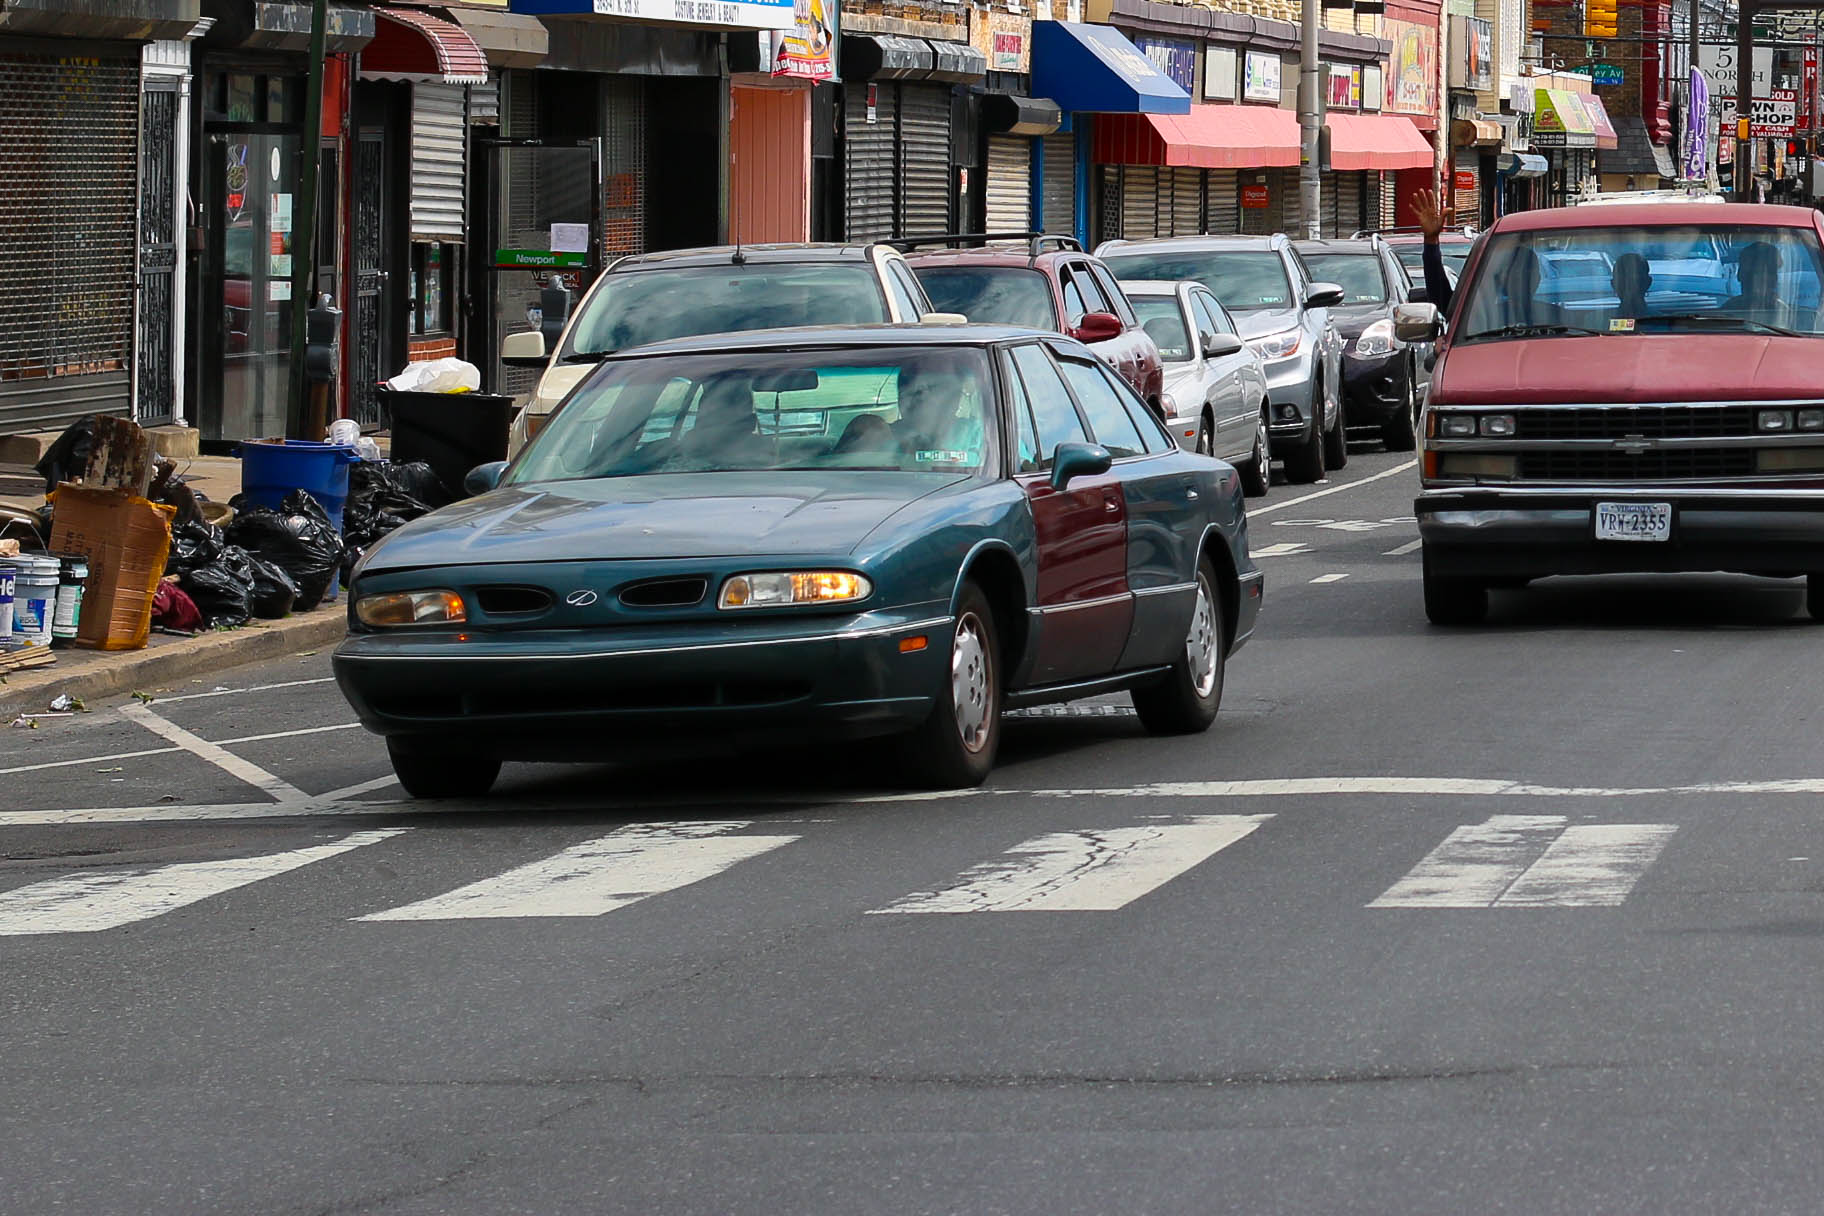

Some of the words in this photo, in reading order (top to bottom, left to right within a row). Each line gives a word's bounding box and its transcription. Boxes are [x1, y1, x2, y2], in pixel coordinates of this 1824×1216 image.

[723, 4, 740, 23] BEAUTY
[1578, 69, 1606, 78] Oley
[1704, 69, 1764, 82] NORH
[516, 254, 555, 265] Newport
[1615, 504, 1652, 513] VIRGINIA
